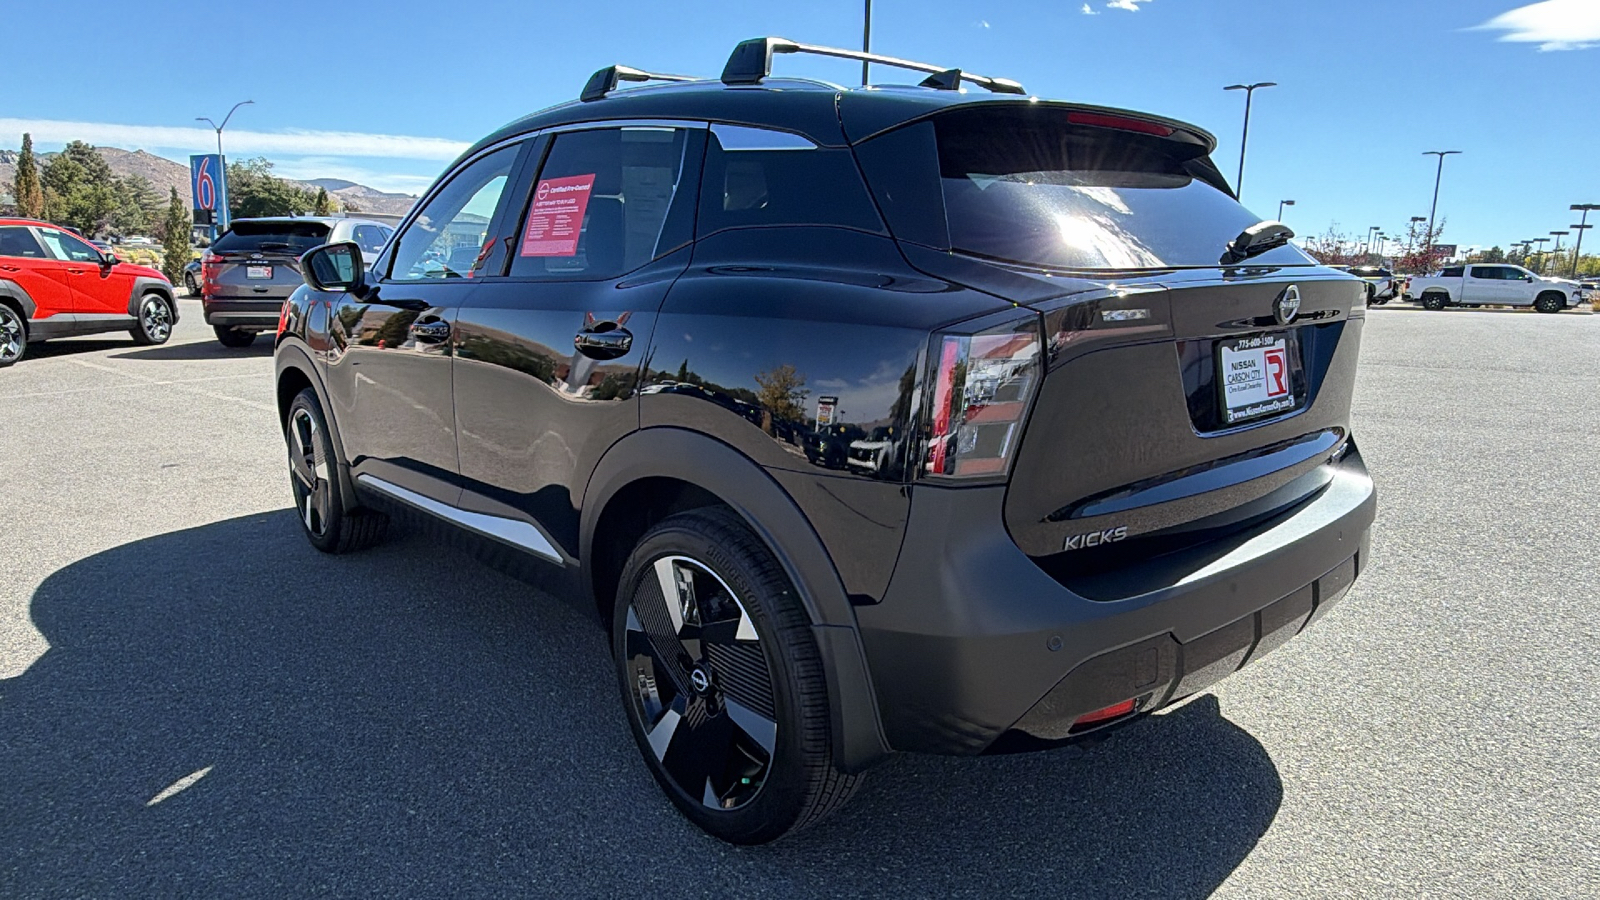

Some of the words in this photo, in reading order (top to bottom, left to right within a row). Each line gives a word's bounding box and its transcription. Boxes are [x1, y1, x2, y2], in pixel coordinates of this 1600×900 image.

[197, 156, 215, 210] 6
[1238, 336, 1274, 349] 775-600-1500
[1231, 359, 1256, 371] NISSAN
[1227, 371, 1250, 384] CARSON
[1250, 369, 1260, 380] CITY
[1064, 526, 1128, 551] KICKS
